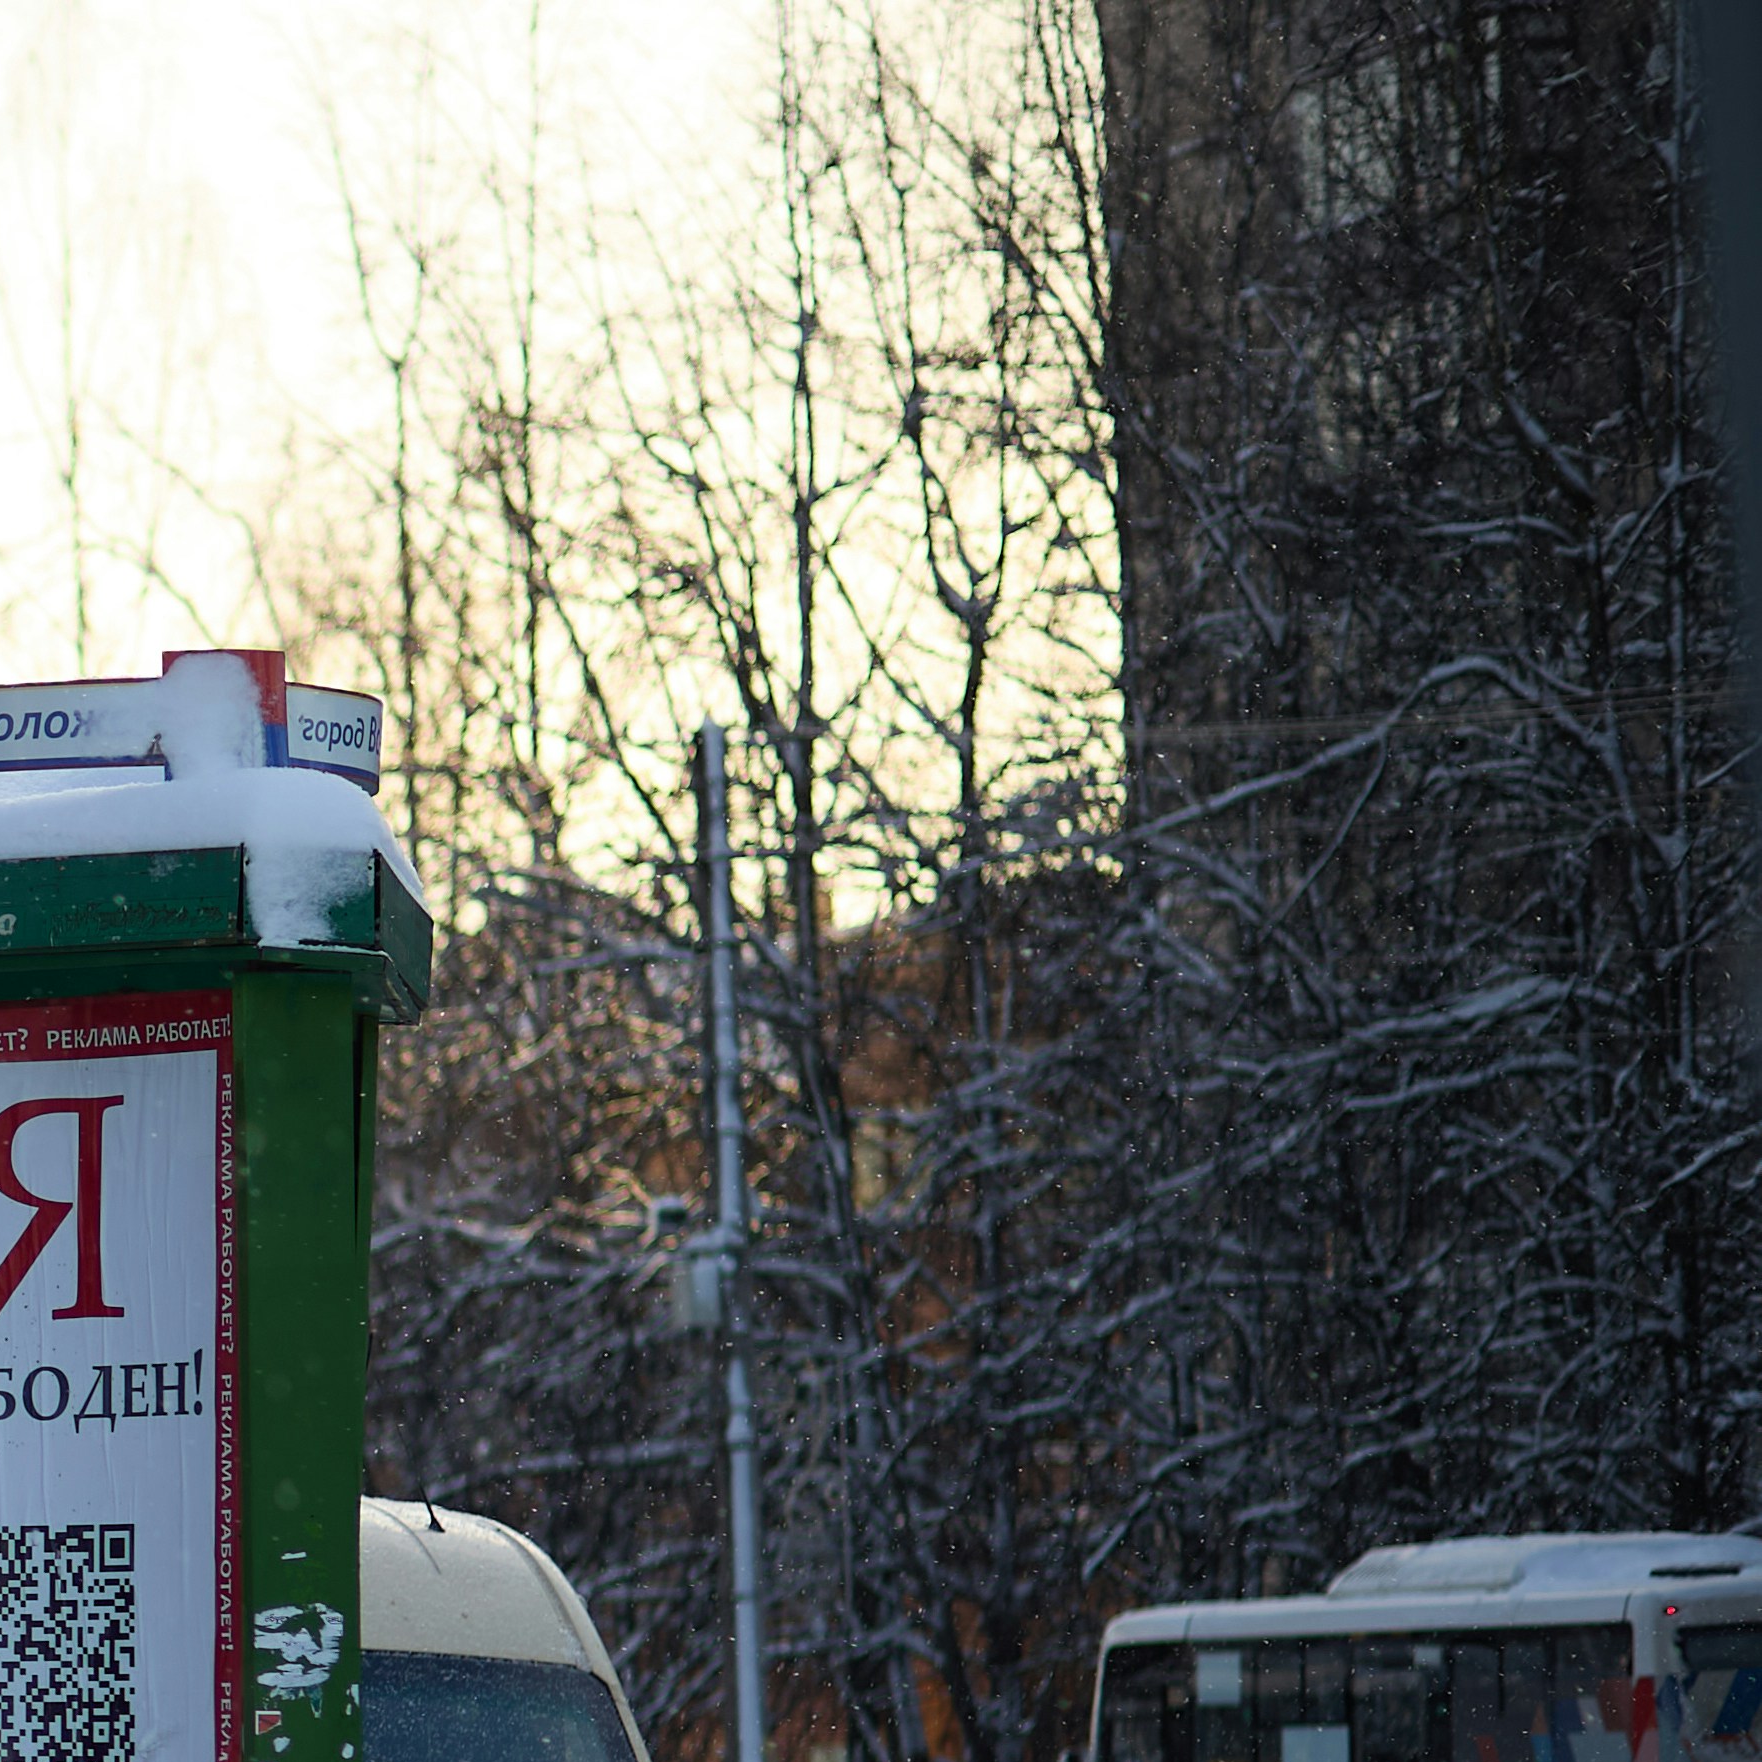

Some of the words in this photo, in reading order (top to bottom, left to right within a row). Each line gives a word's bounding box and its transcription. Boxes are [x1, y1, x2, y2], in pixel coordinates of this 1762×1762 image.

[299, 715, 366, 752] город
[46, 1025, 141, 1050] РЕКЛАМА
[145, 1013, 231, 1043] РАБОТАЕТ!
[220, 1073, 233, 1201] РЕКЛАМА
[220, 1207, 235, 1355] РАБОТАЕТ?
[220, 1373, 233, 1501] РЕКЛАМА
[220, 1508, 234, 1651] РАБОТАЕТ!
